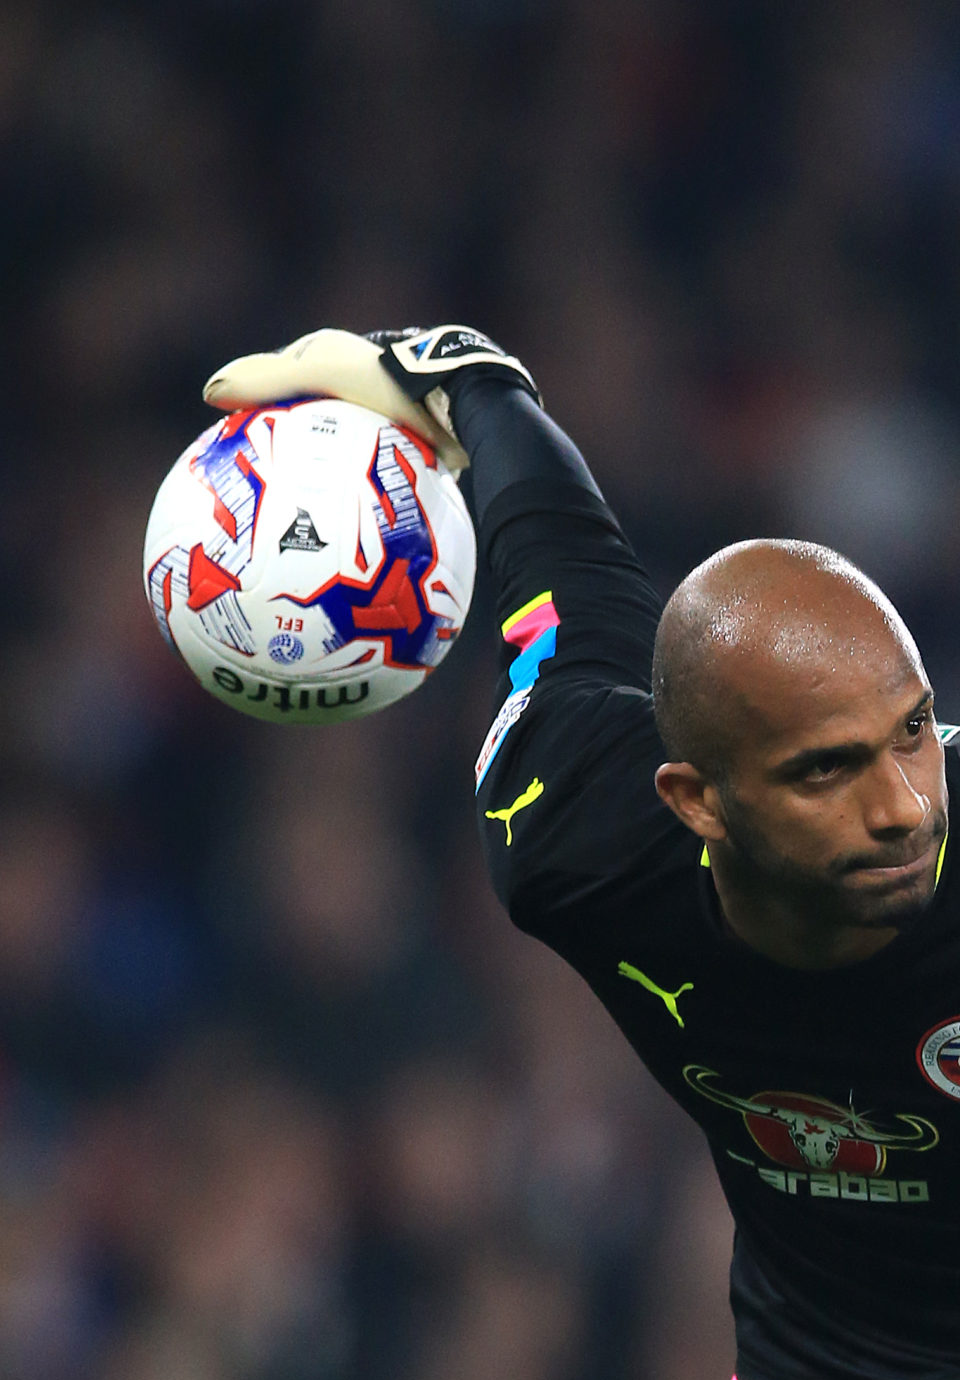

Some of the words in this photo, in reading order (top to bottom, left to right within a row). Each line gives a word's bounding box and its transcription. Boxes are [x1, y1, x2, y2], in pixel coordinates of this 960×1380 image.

[275, 616, 304, 632] EFL
[213, 667, 369, 712] mitre
[925, 1030, 952, 1067] READING
[733, 1155, 930, 1202] arabao
